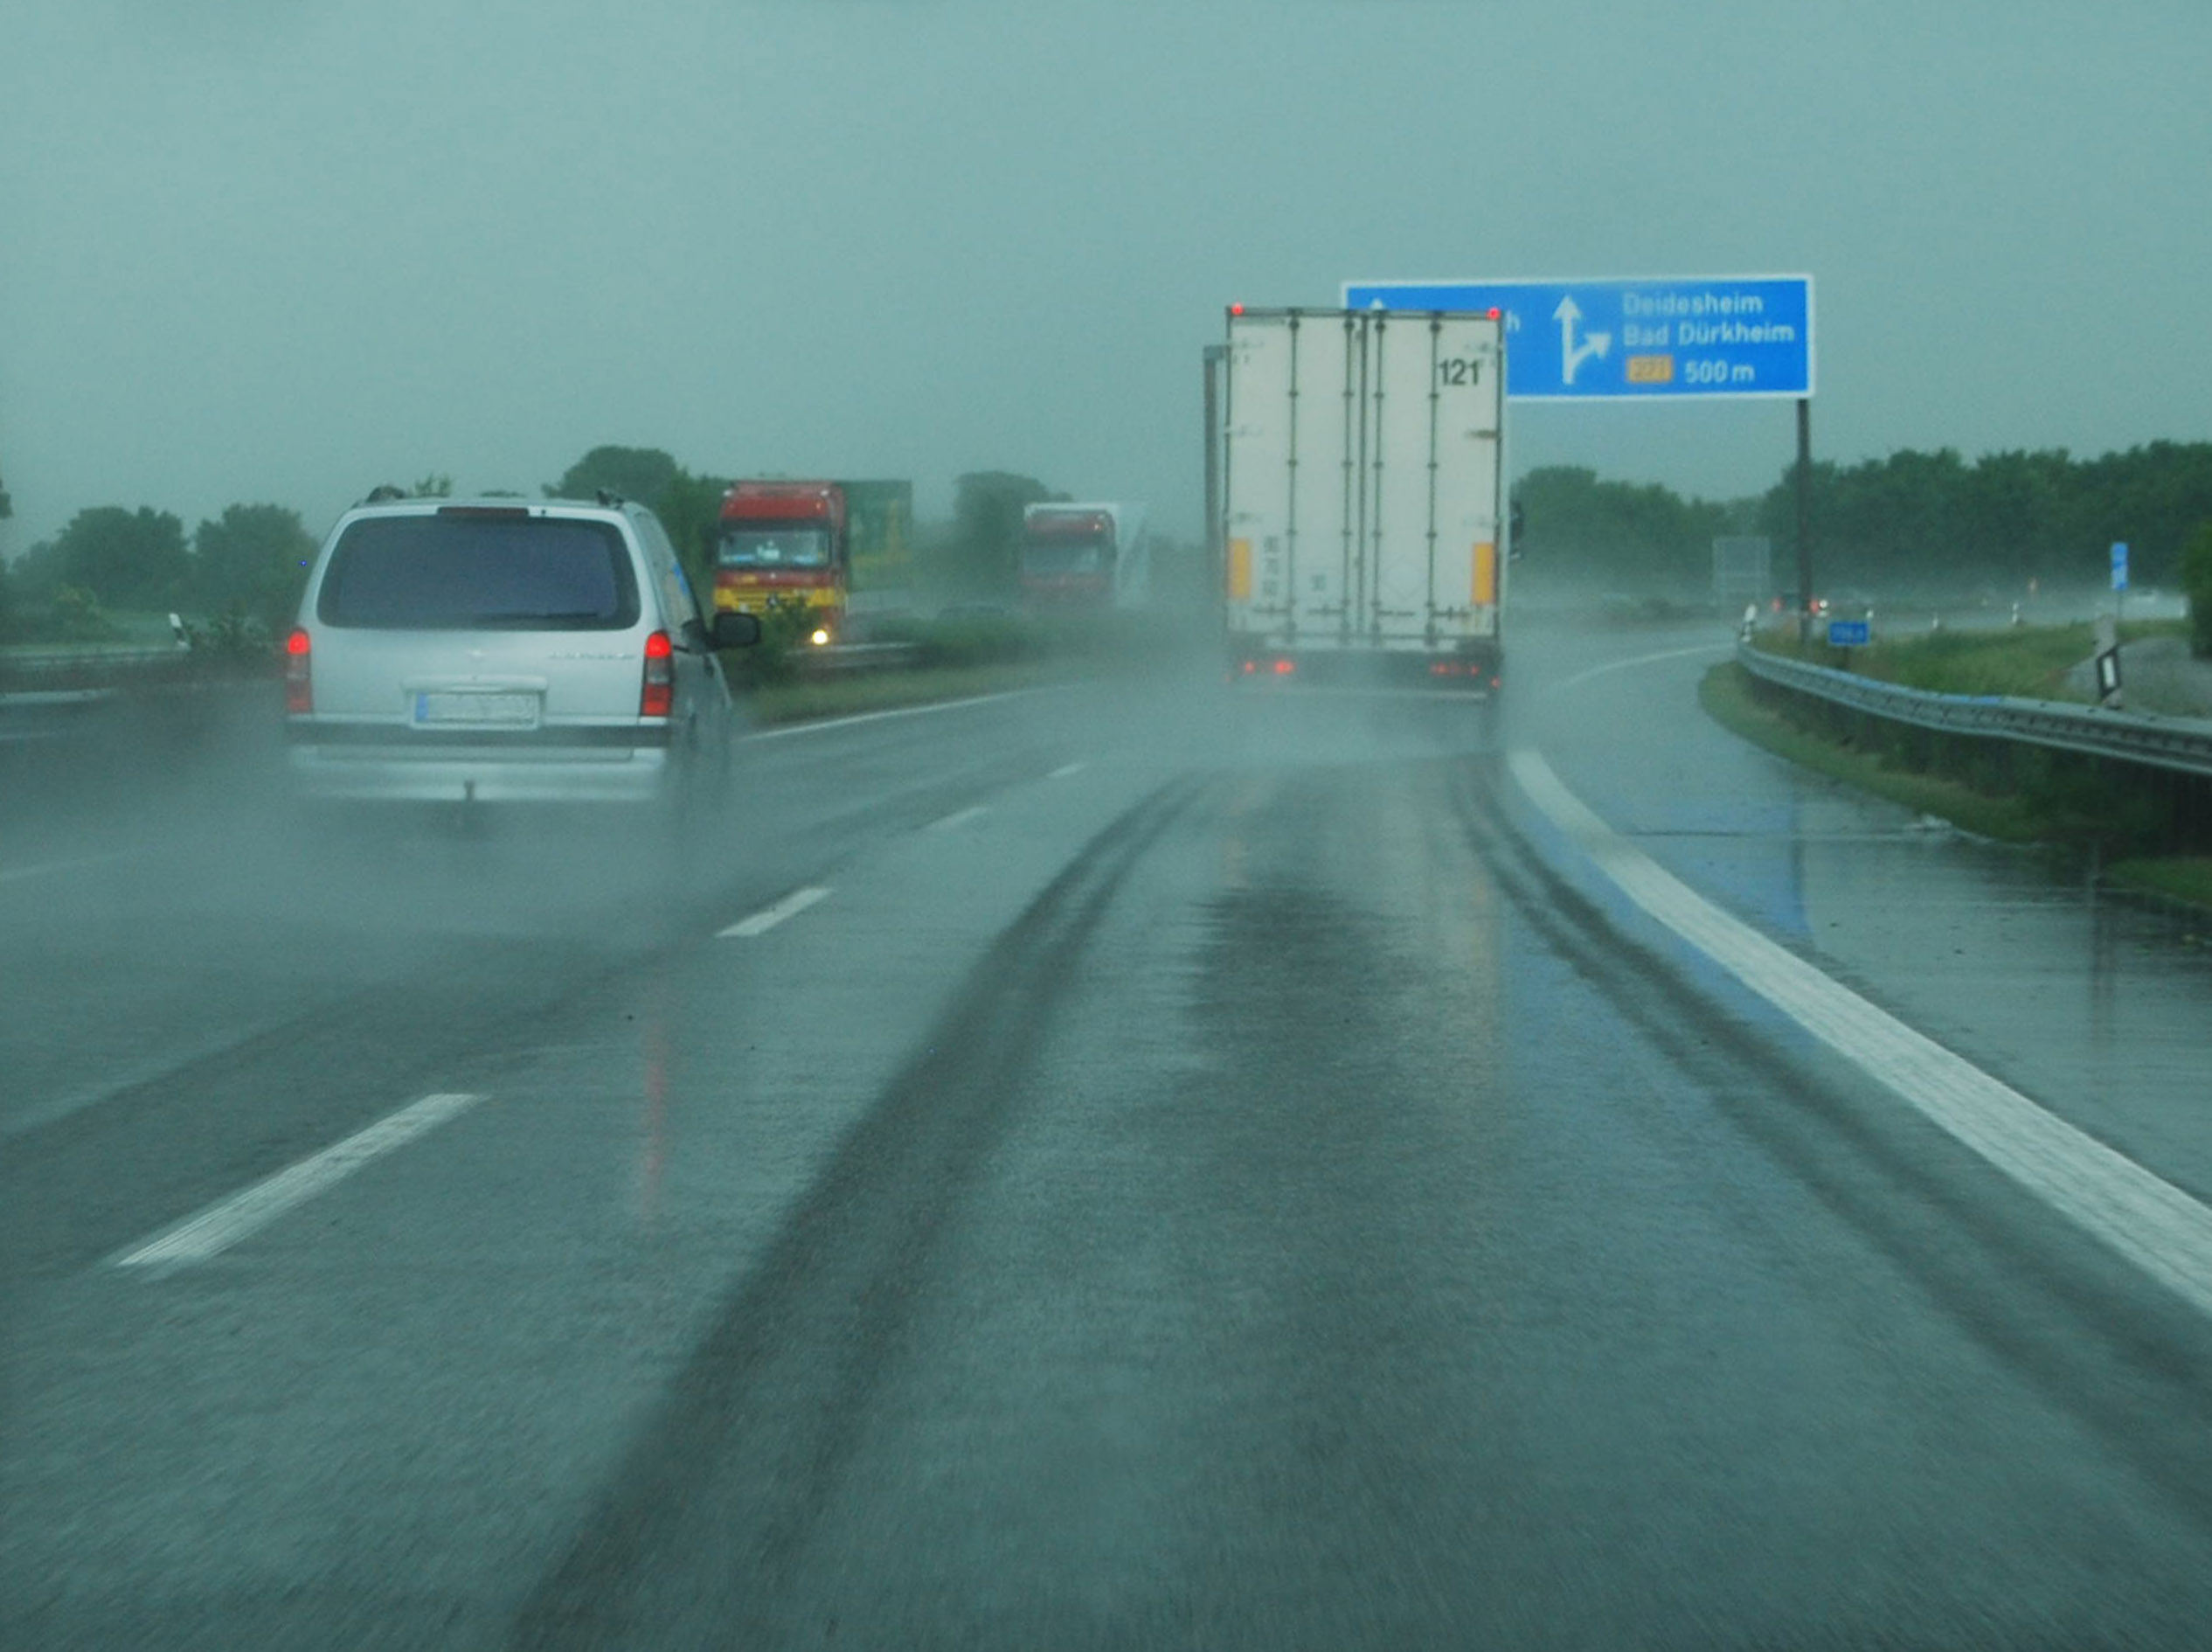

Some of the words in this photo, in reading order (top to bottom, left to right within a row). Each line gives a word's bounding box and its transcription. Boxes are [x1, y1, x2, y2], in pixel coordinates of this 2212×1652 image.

[1624, 292, 1764, 316] Deidesheim
[1624, 323, 1668, 346] Bad
[1678, 320, 1795, 345] Dürkheim
[1439, 358, 1479, 385] 121
[1685, 359, 1729, 383] 500
[1732, 364, 1755, 383] m
